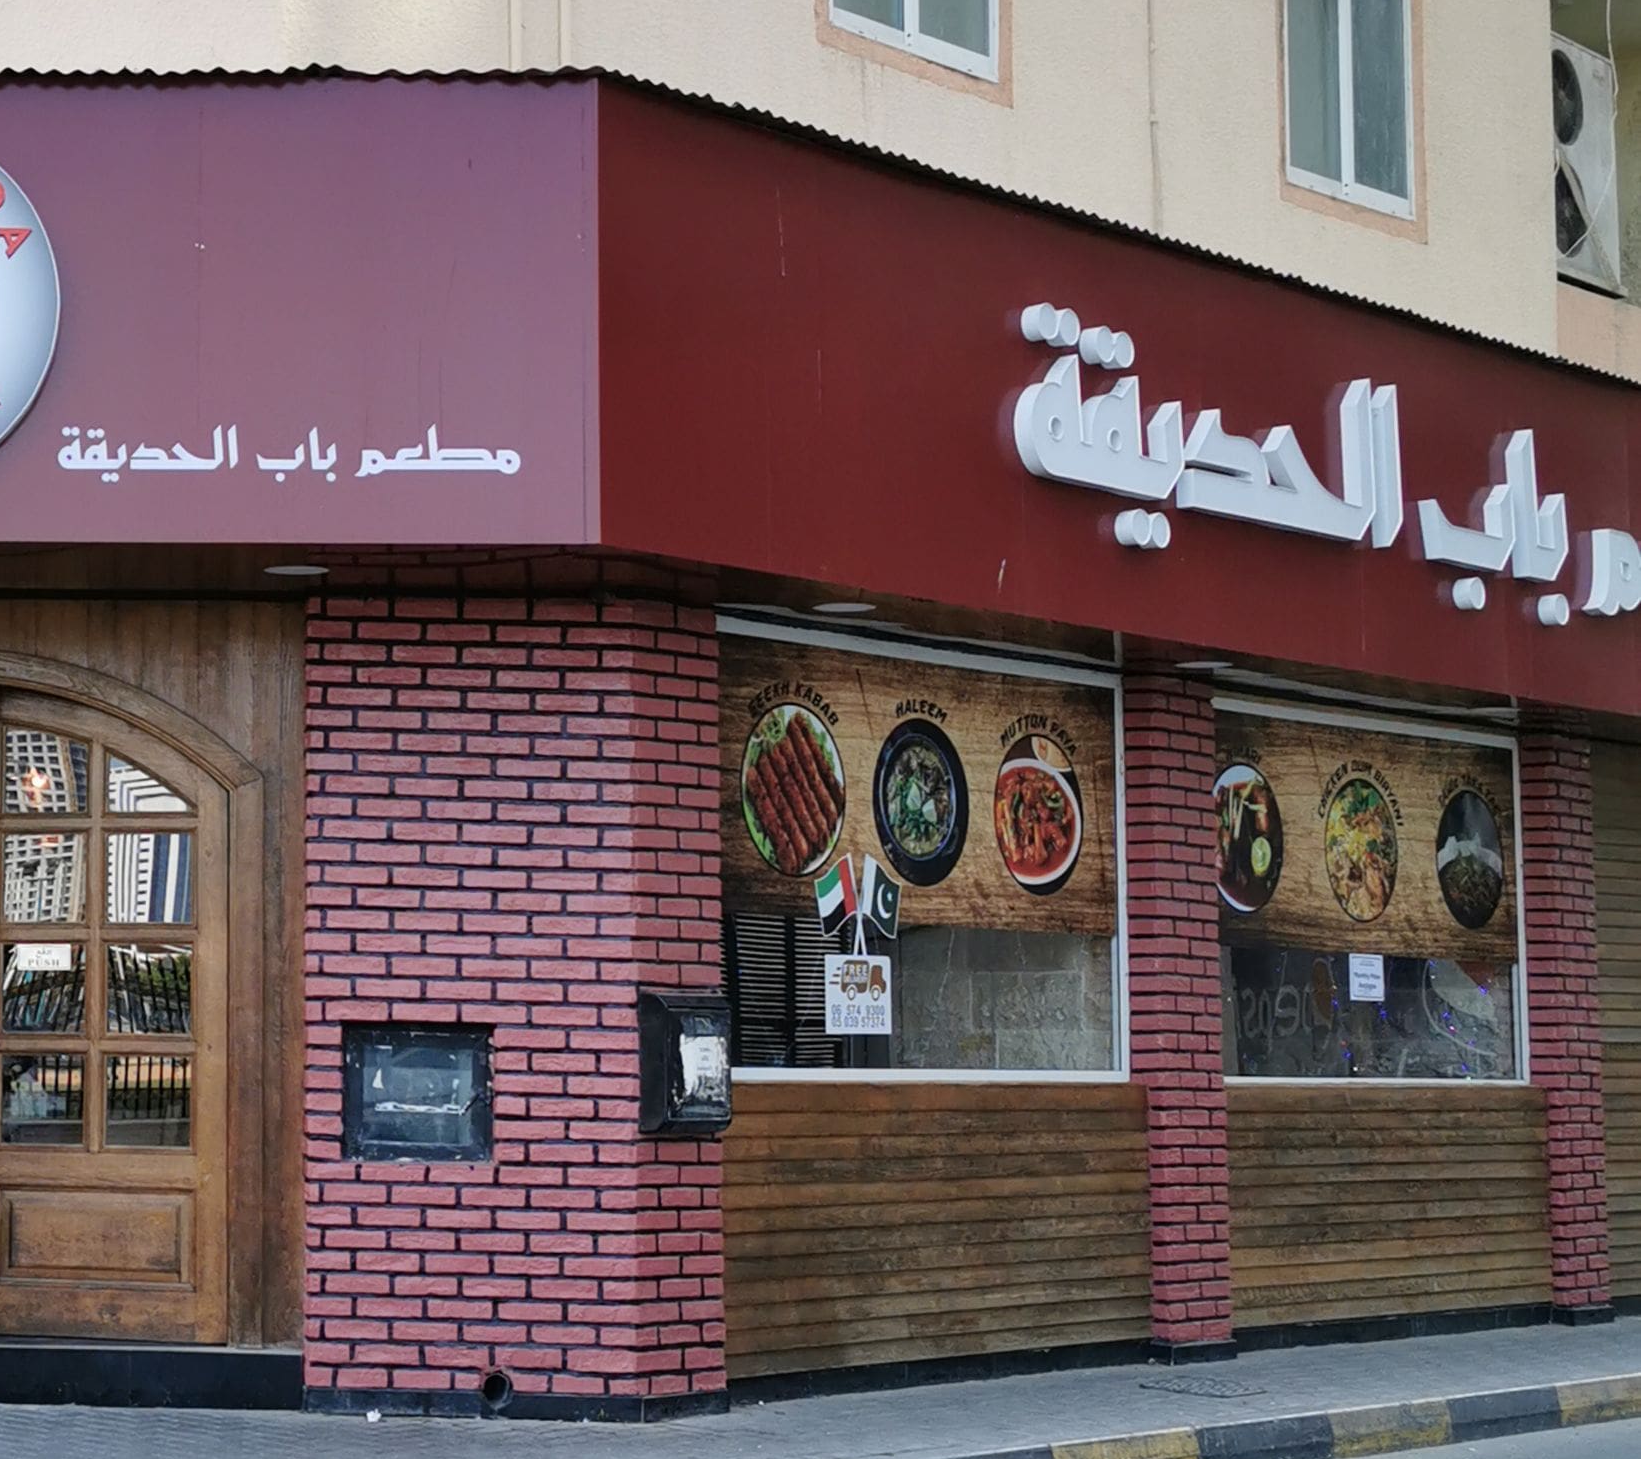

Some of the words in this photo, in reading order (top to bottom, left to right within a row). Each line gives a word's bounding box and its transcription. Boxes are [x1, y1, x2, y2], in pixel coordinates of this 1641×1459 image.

[354, 423, 522, 477] مطعم
[1013, 301, 1404, 551] الحديقة
[57, 424, 239, 484] الحديقة
[256, 426, 338, 483] باب
[1418, 428, 1570, 627] باب
[794, 682, 840, 726] KABAB
[896, 700, 948, 724] HALEEM
[1000, 713, 1048, 750] MUTTON
[28, 958, 60, 967] PUSH
